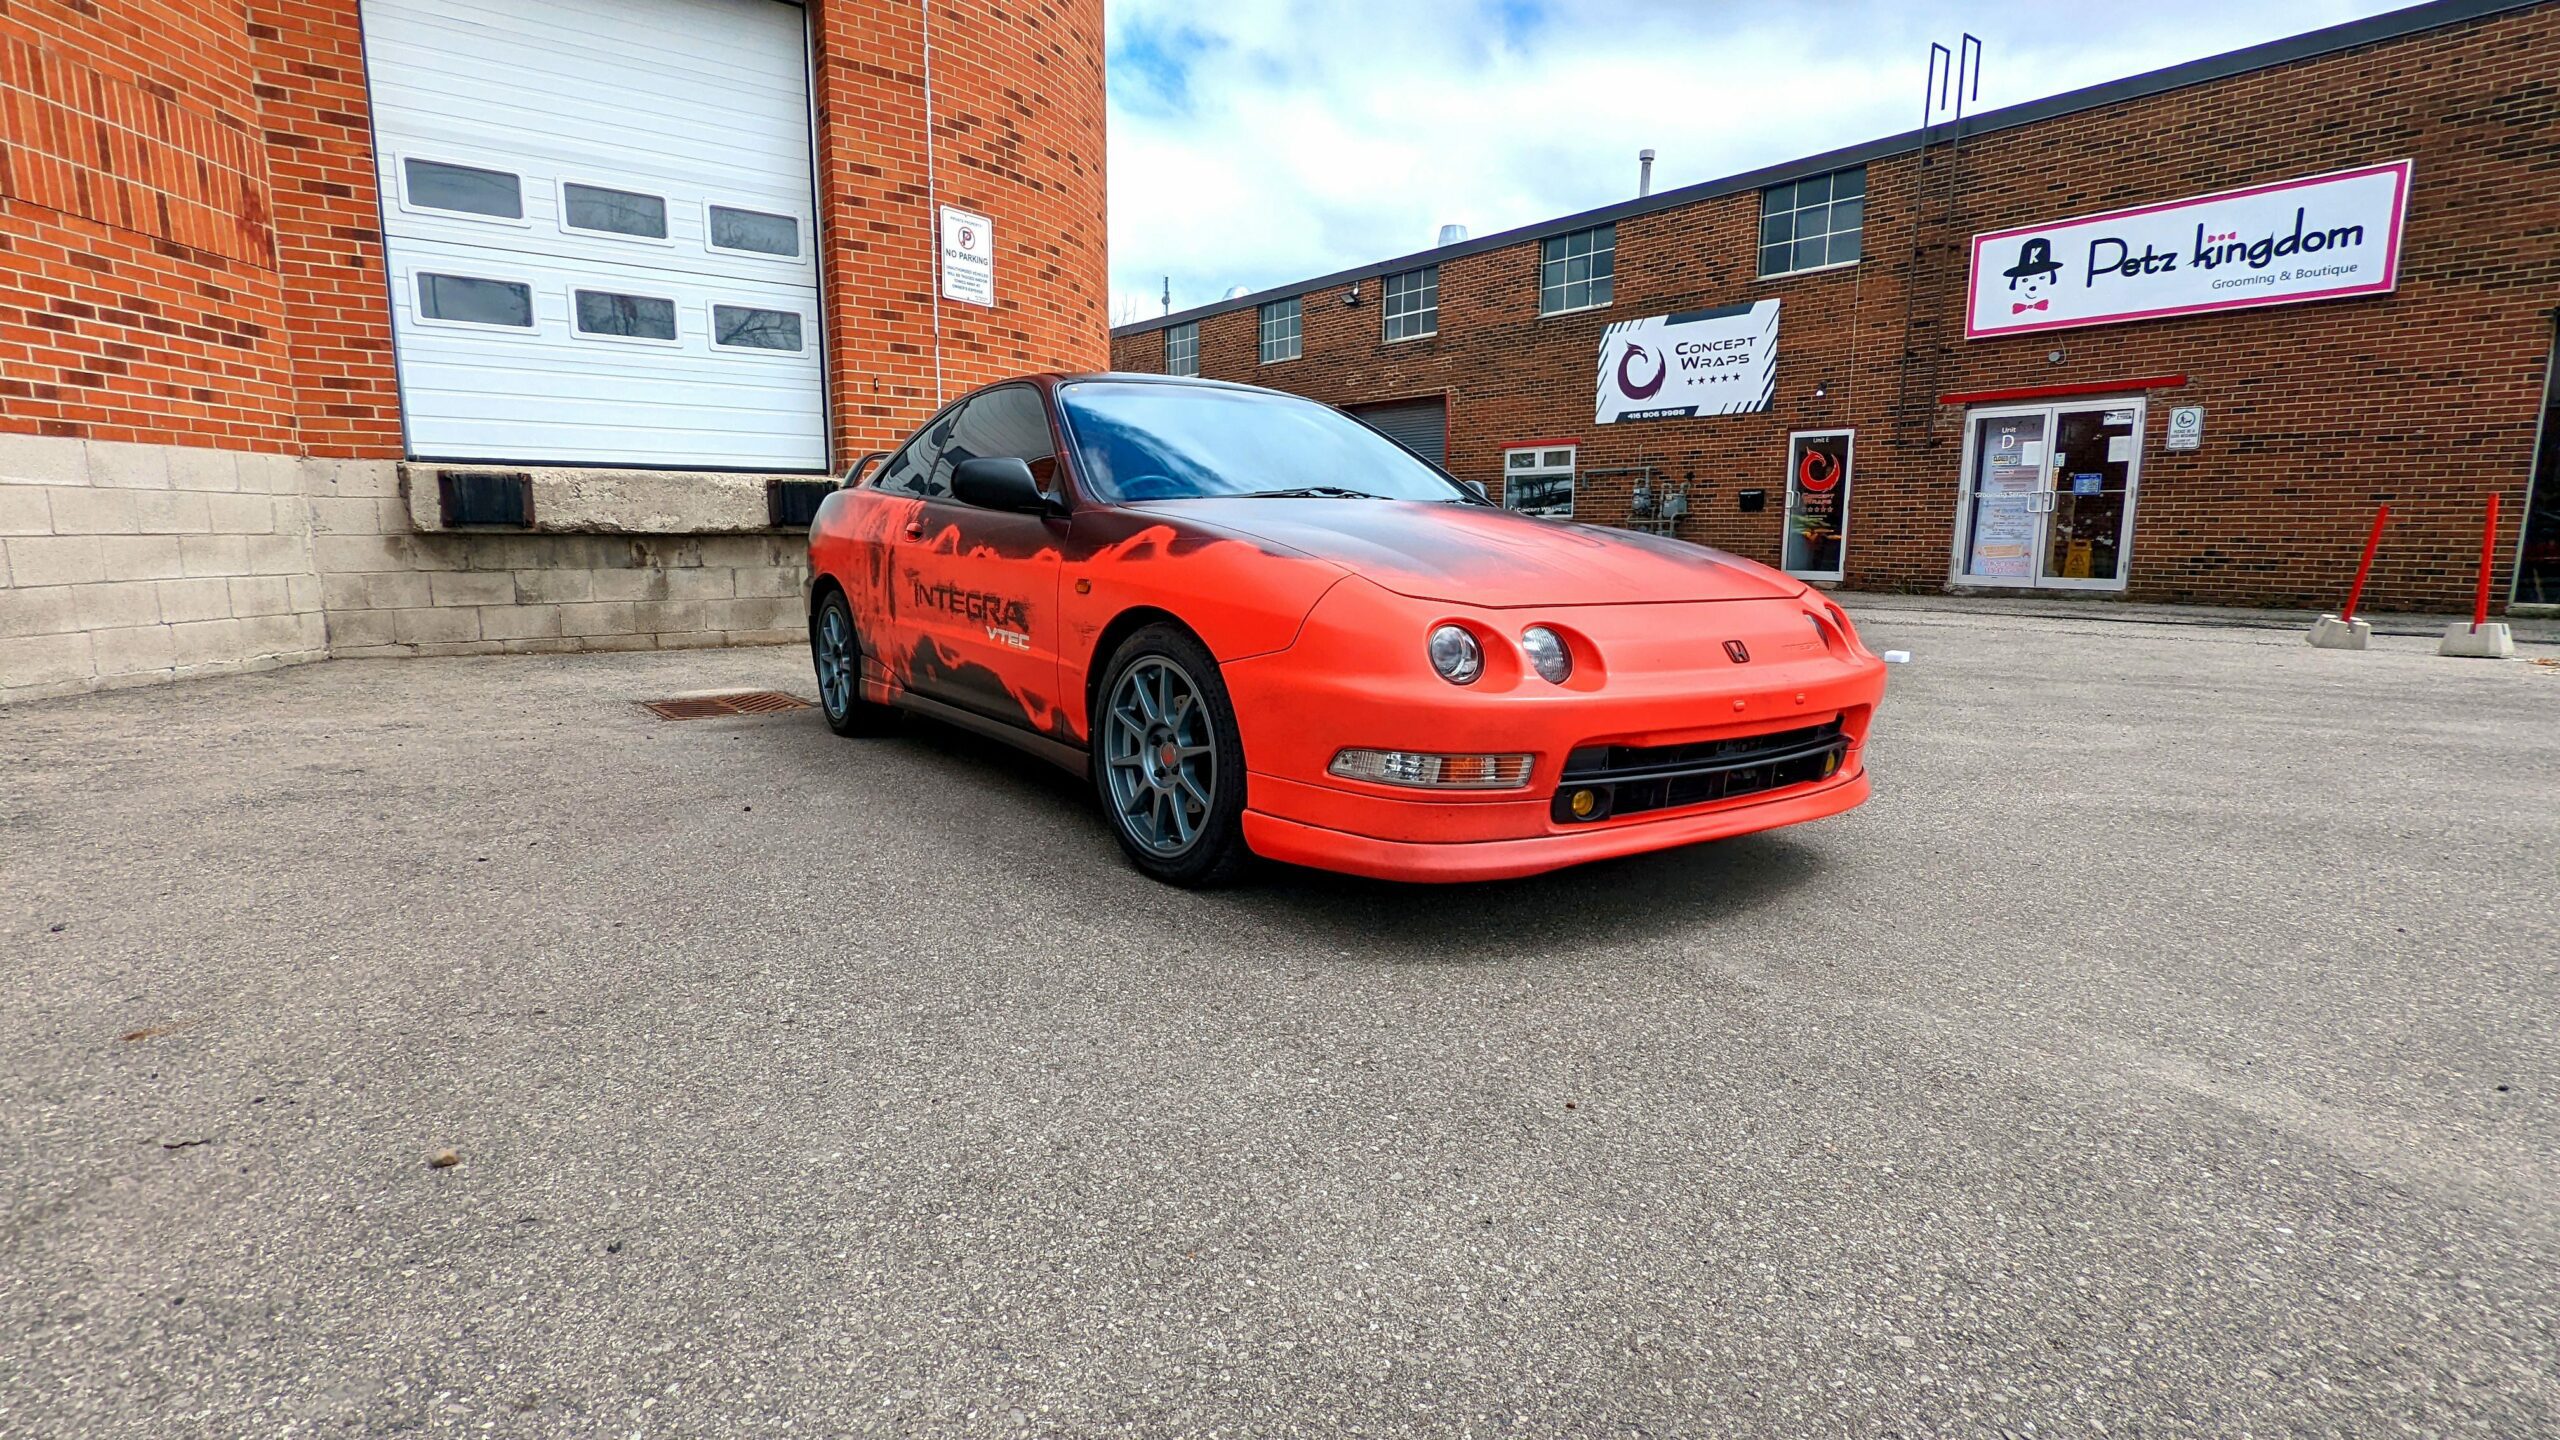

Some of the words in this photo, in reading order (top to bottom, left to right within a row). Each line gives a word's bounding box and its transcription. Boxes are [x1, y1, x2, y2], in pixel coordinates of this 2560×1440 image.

[2026, 247, 2042, 265] K
[2085, 237, 2178, 288] Petz
[2186, 207, 2365, 270] kingdom
[945, 248, 957, 258] NO
[958, 251, 988, 266] PARKING
[2211, 269, 2275, 290] Grooming
[2279, 270, 2293, 282] &
[2295, 261, 2359, 282] Boutique
[1675, 336, 1758, 356] CONCEPT
[1680, 353, 1750, 371] WRAPS
[1627, 411, 1641, 420] 416
[1642, 410, 1660, 419] 806
[2001, 426, 2016, 434] Unit
[2001, 434, 2015, 449] D
[913, 580, 1031, 633] INTEGRA
[985, 625, 1030, 650] VTEC
